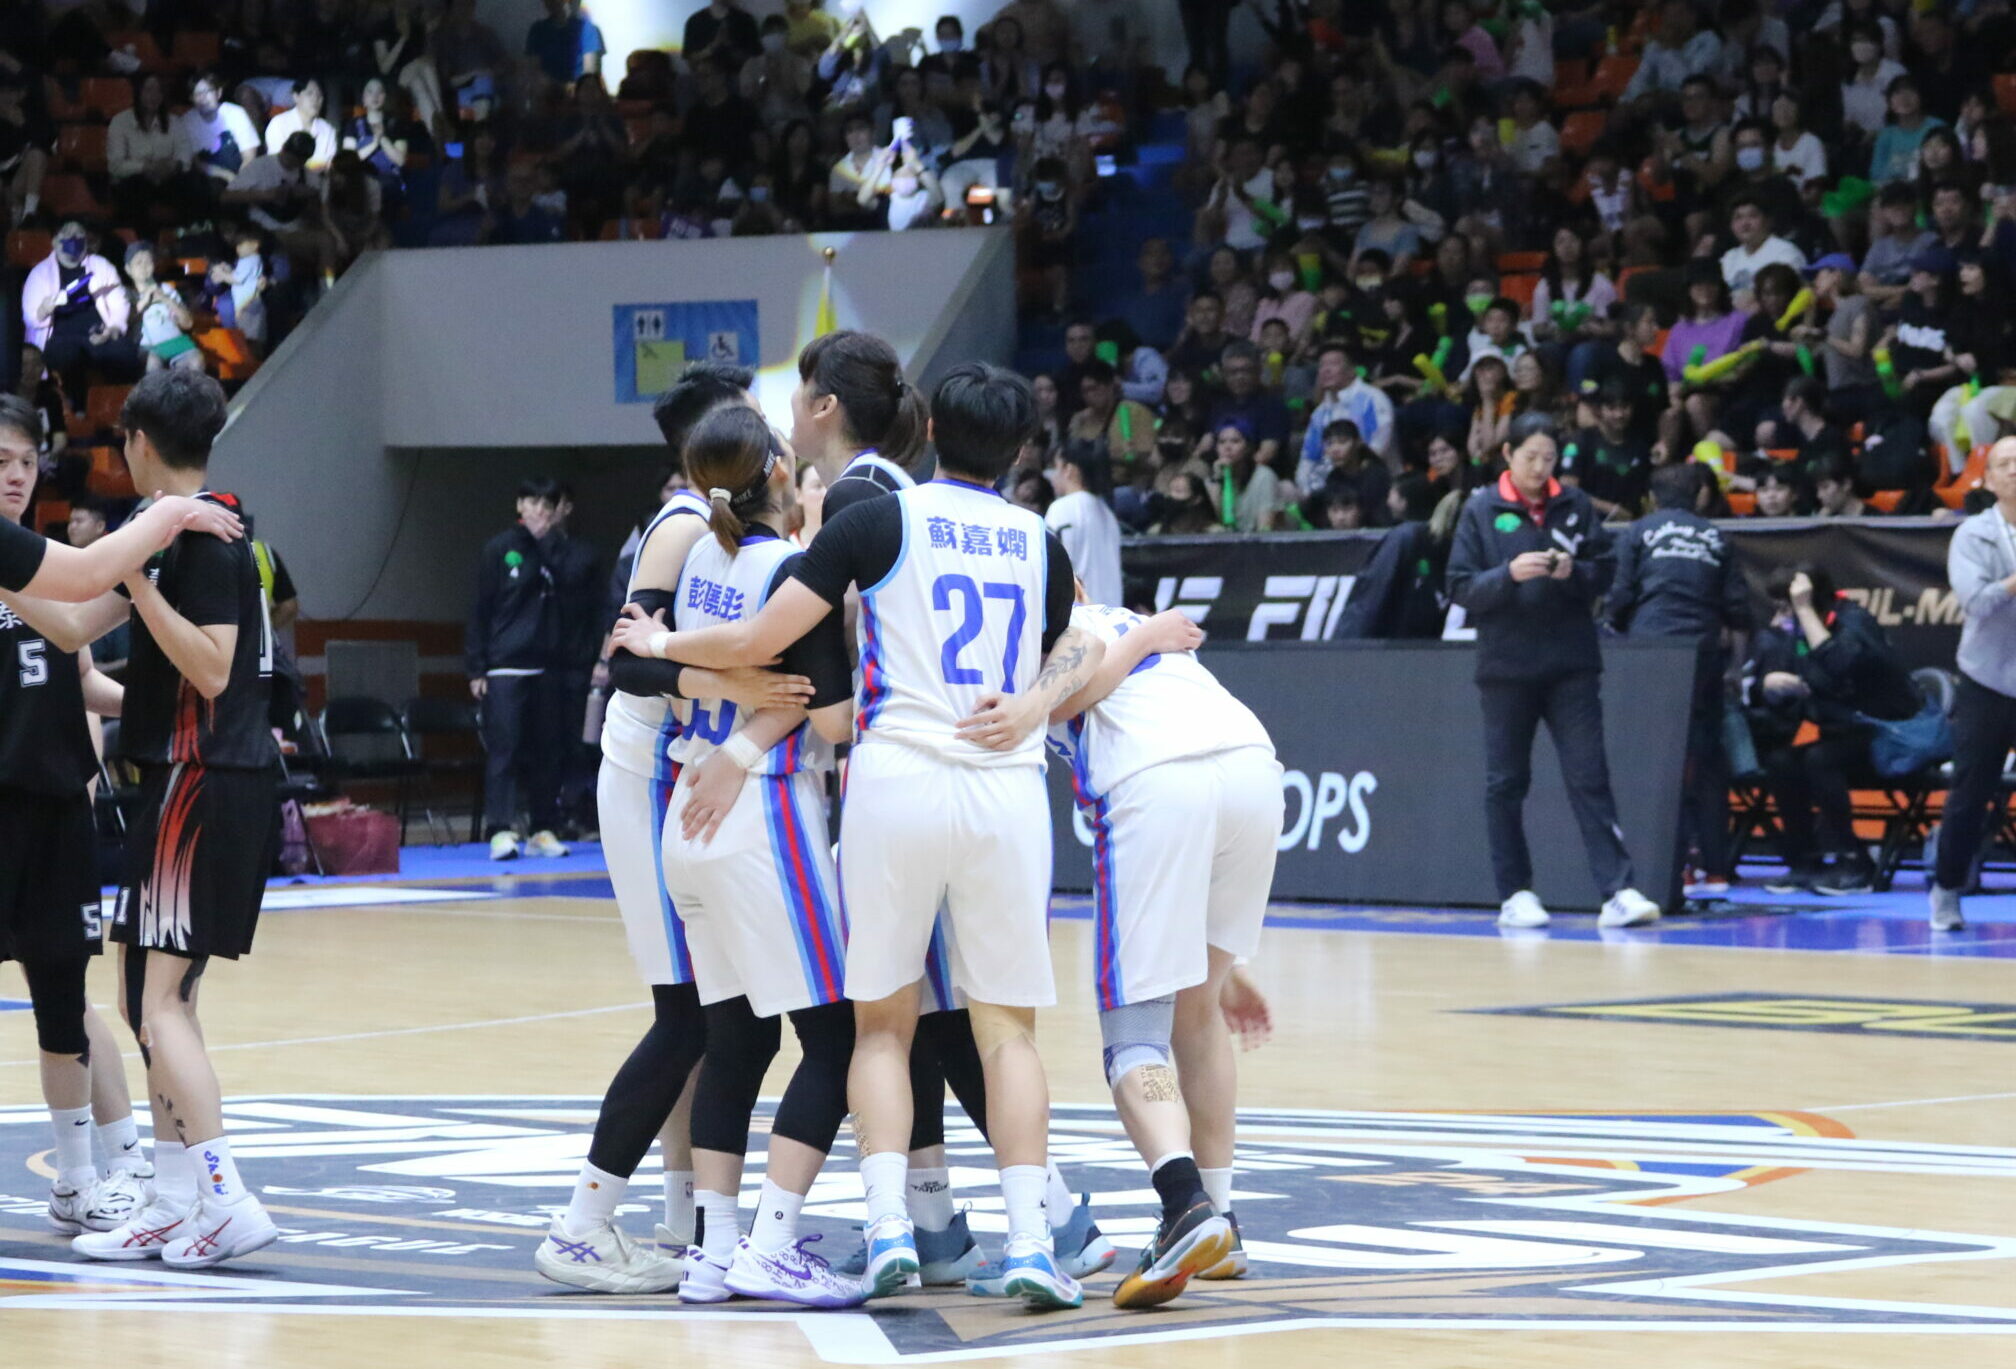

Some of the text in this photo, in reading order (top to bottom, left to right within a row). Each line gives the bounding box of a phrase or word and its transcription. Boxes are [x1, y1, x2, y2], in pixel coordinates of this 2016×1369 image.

[932, 573, 1027, 694] 27
[18, 638, 48, 688] 5
[80, 902, 102, 940] 5
[277, 1227, 516, 1255] AGUE
